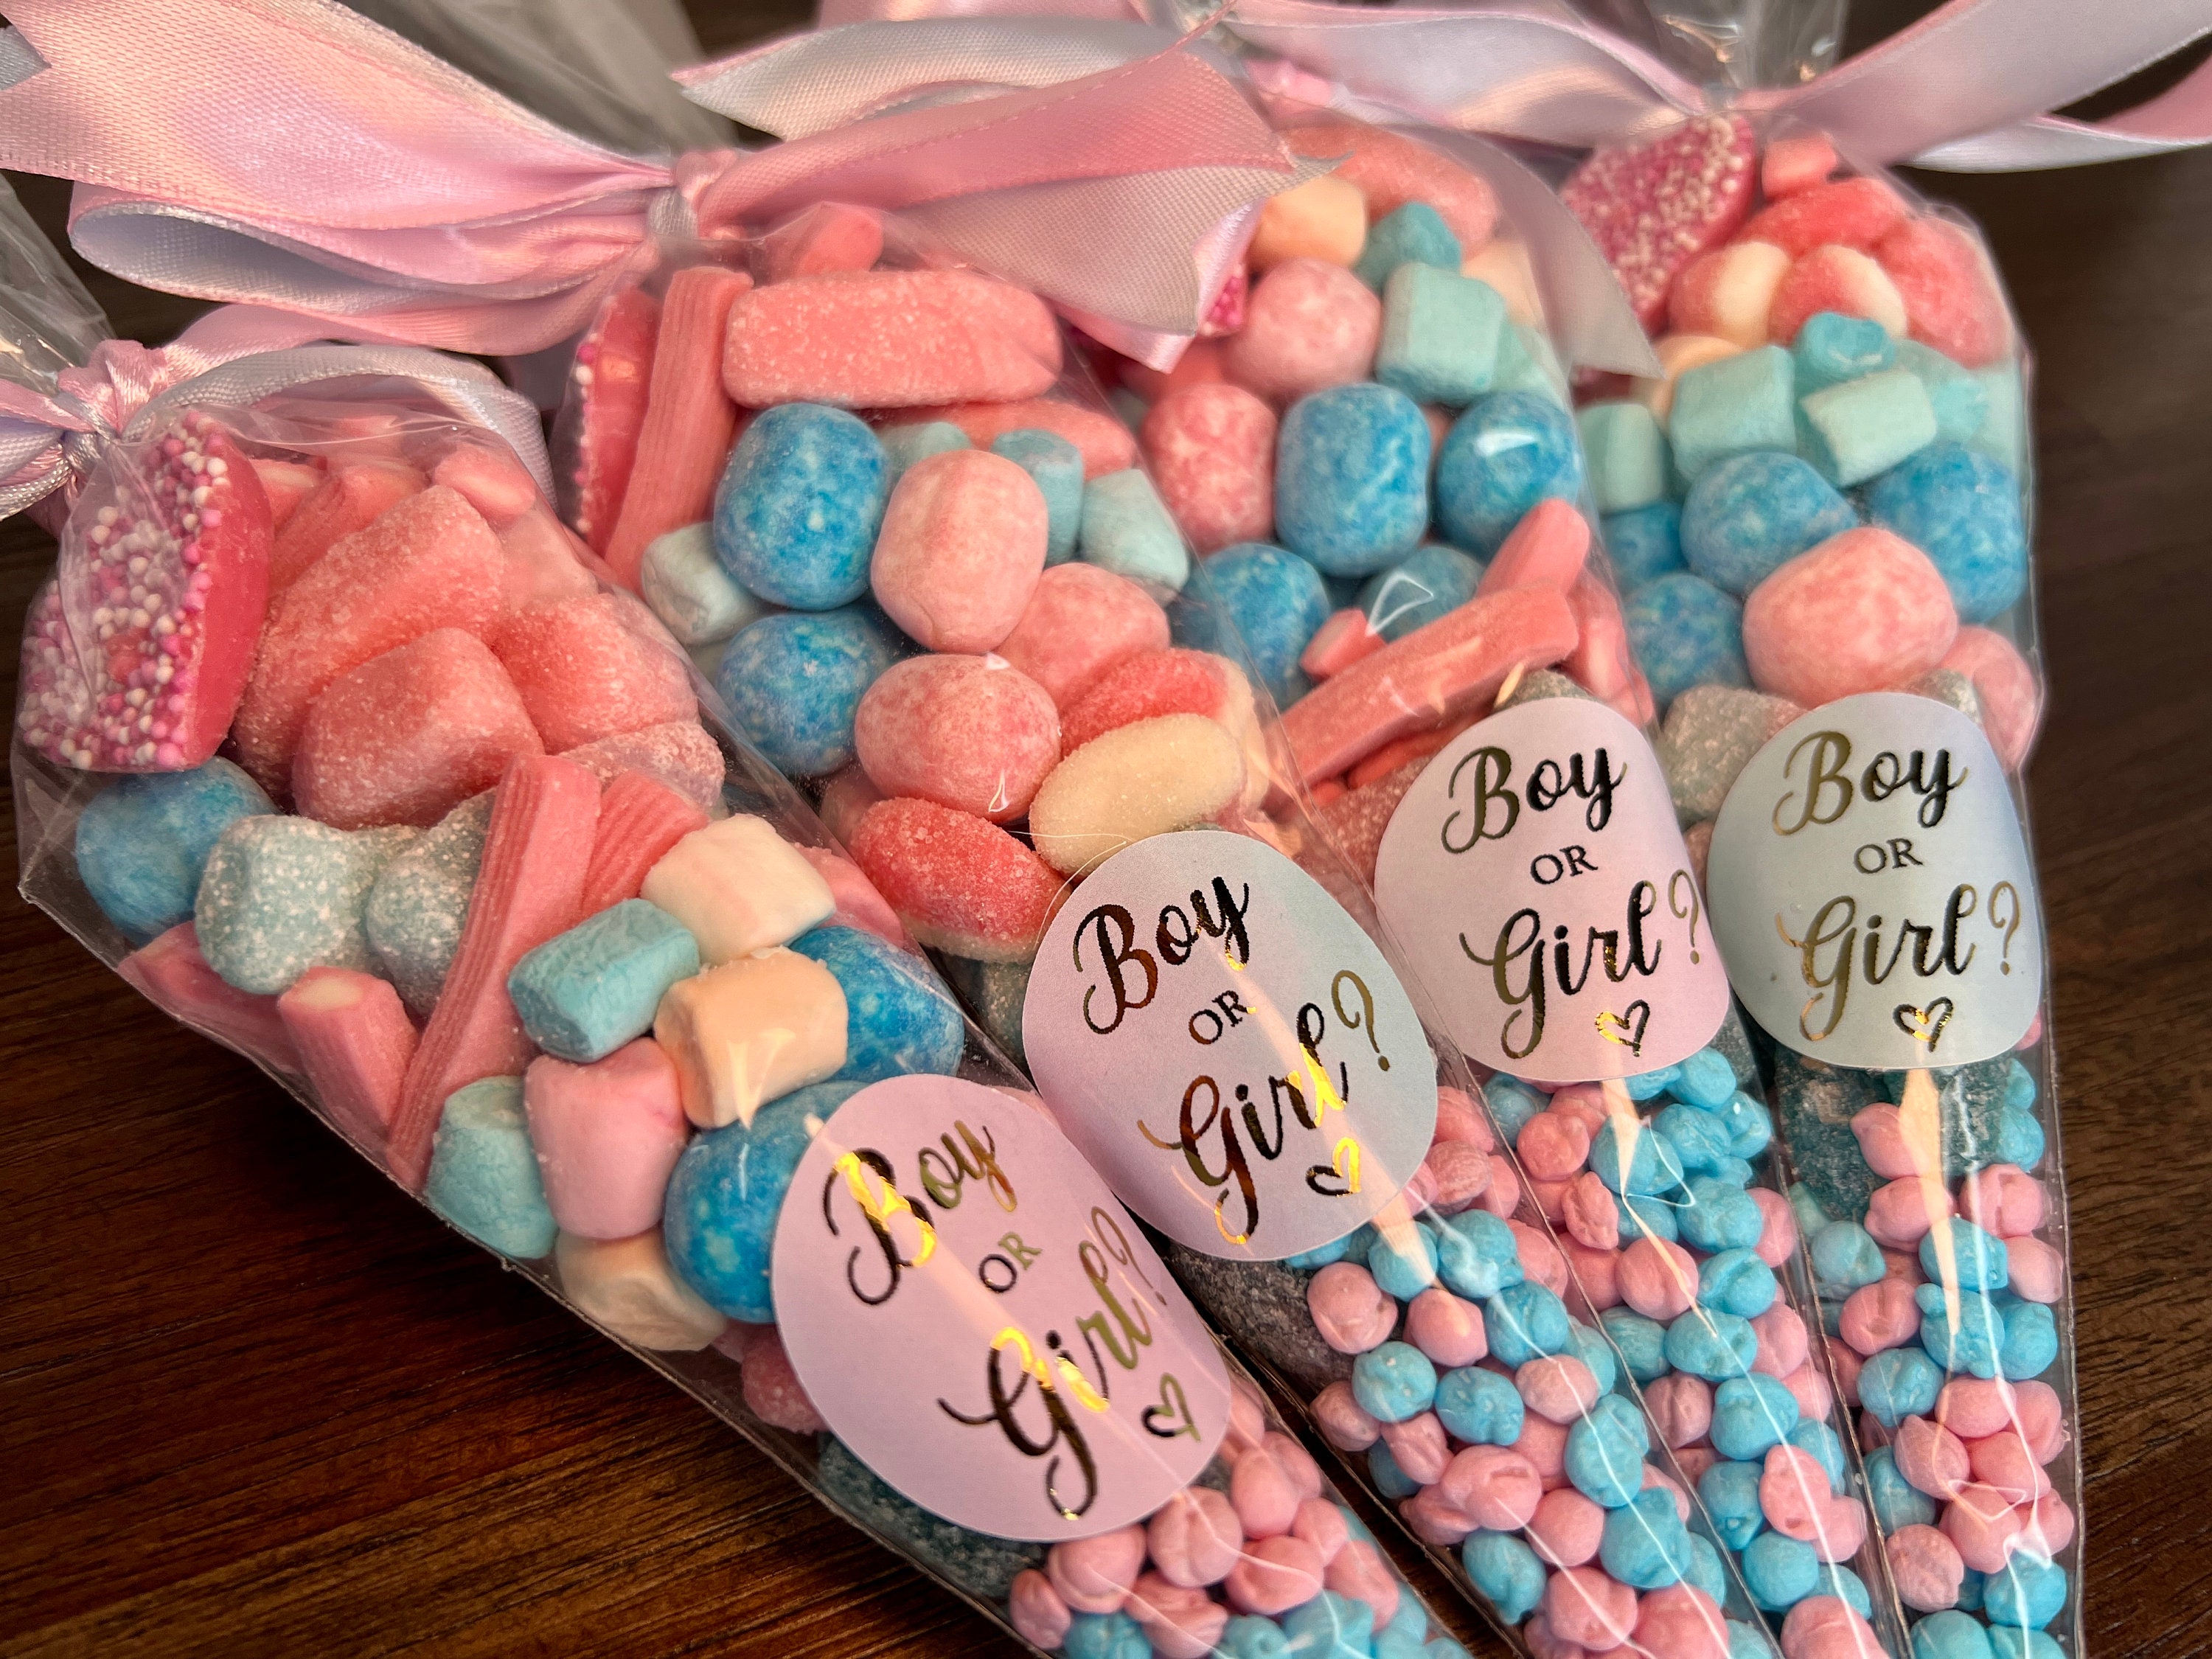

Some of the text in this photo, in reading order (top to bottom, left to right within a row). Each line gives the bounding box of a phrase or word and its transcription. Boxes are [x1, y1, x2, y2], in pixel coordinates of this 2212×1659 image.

[1441, 745, 1627, 854] Boy
[1772, 730, 1968, 835] Boy
[1530, 845, 1598, 885] OR
[1854, 838, 1924, 874] OR
[1074, 877, 1250, 1034] Boy
[1189, 990, 1256, 1044] OR
[1459, 869, 1700, 1059] Girl?
[1775, 881, 2020, 1041] Girl?
[1138, 970, 1390, 1245] Girl?
[824, 1120, 1018, 1305] Boy
[978, 1231, 1043, 1293] OR
[939, 1206, 1167, 1520] Girl?
